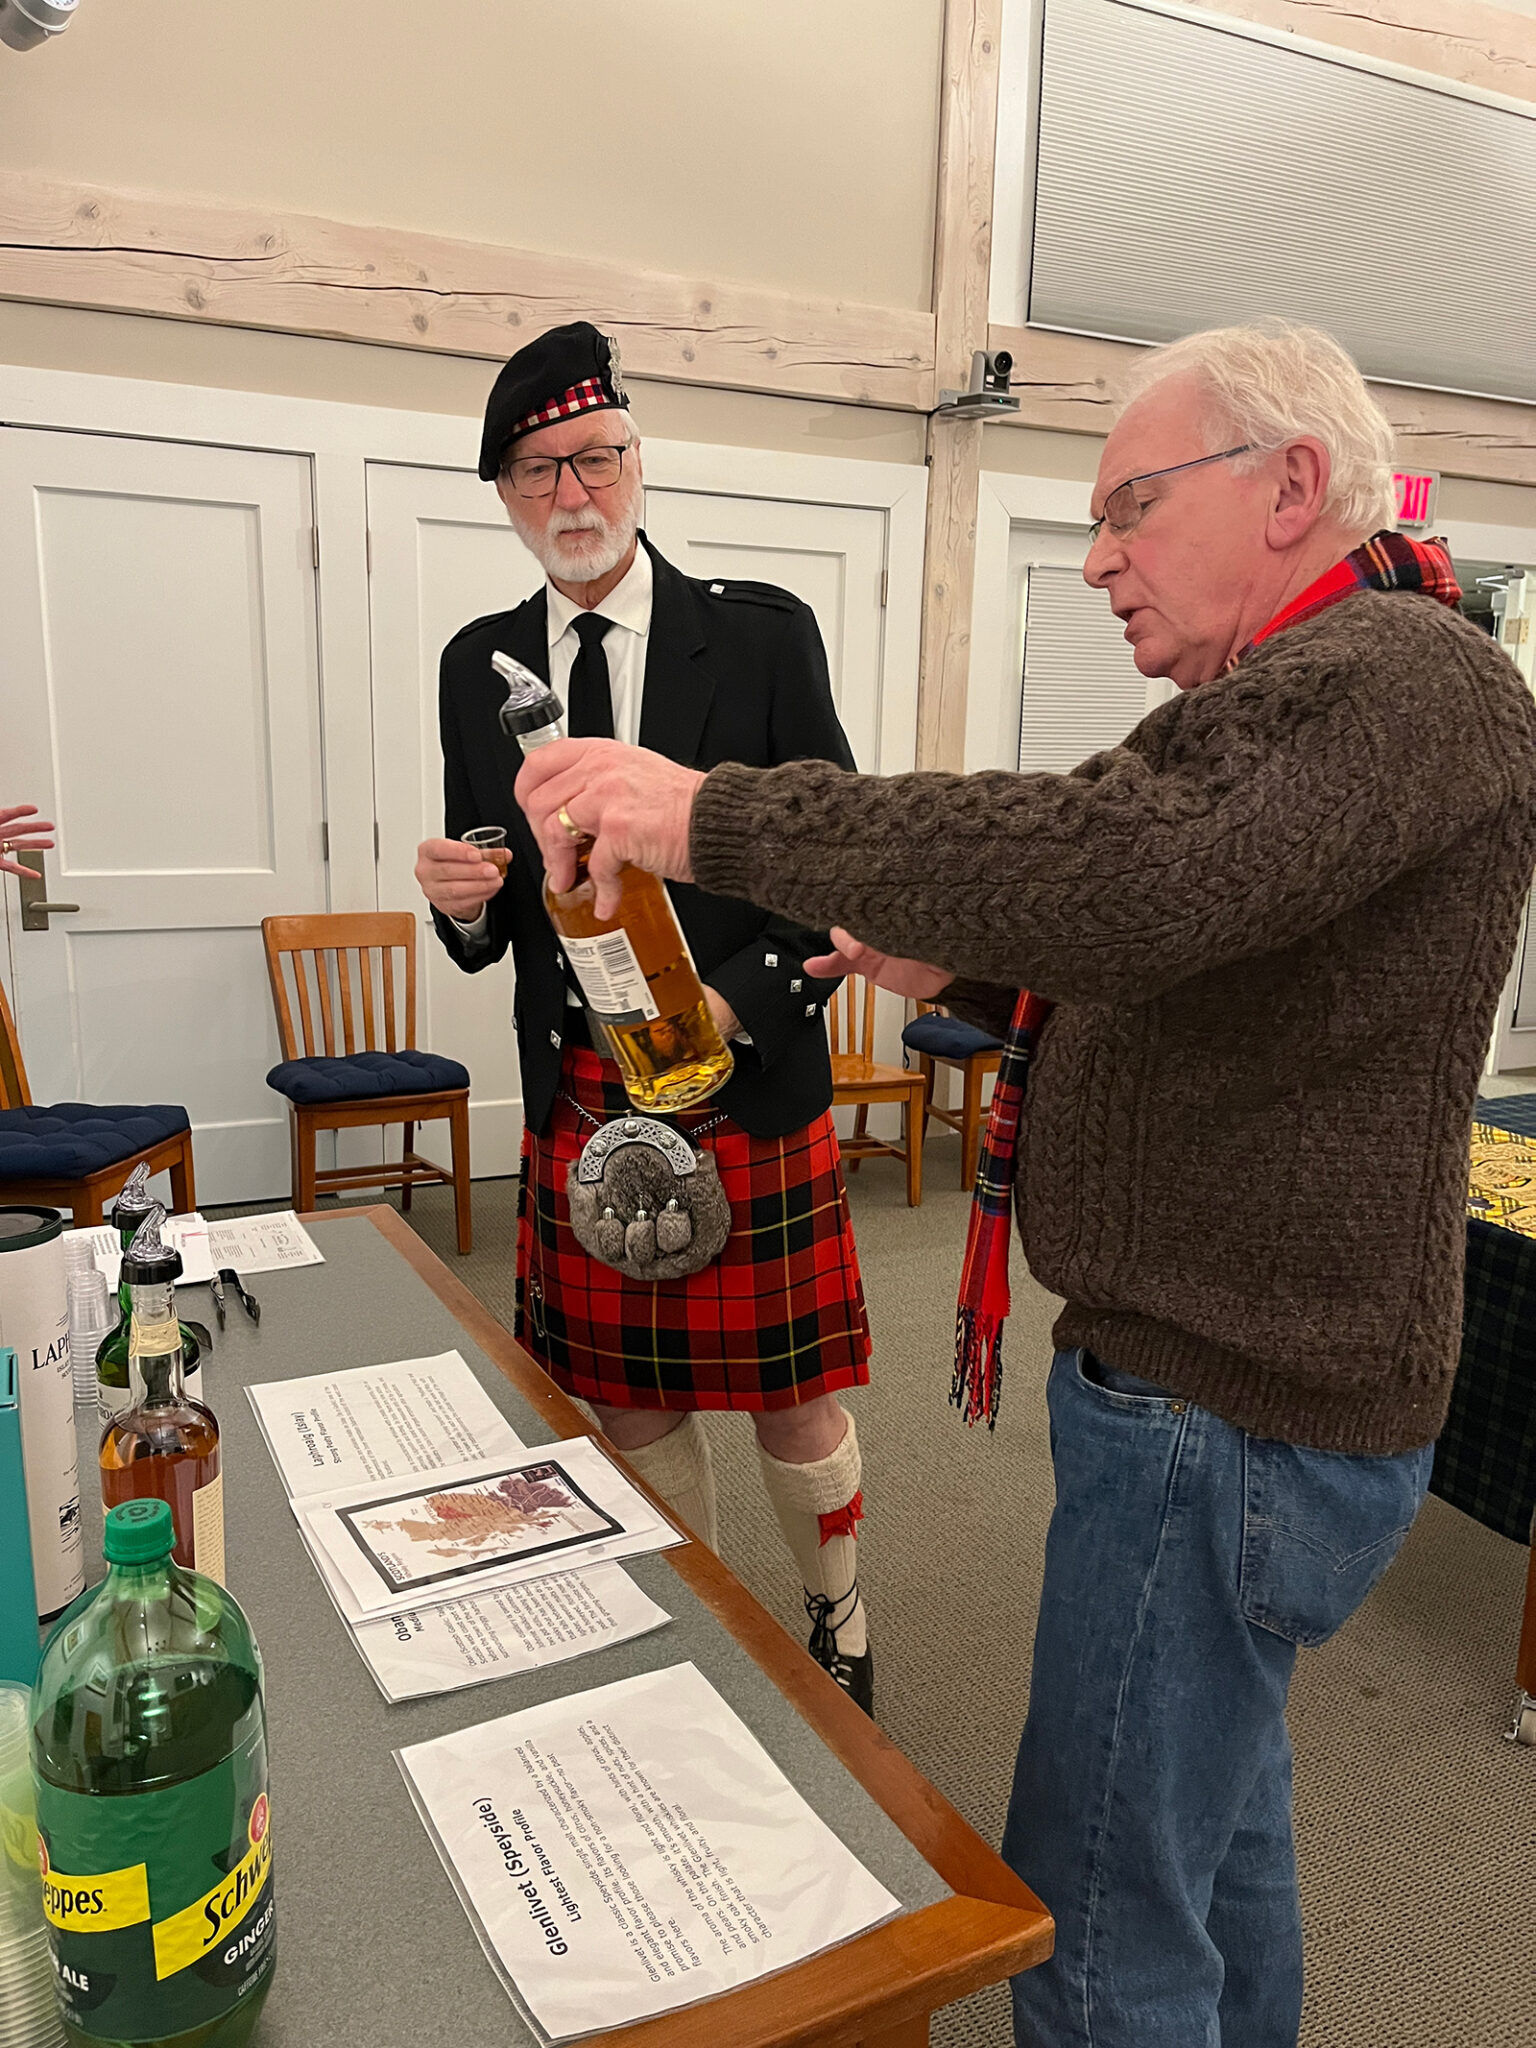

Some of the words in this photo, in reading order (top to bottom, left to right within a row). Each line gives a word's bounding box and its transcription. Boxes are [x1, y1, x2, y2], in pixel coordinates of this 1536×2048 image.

[300, 1432, 324, 1467] Laphroaig
[390, 1615, 411, 1641] Oban
[576, 1798, 603, 1835] non-smoky
[637, 1798, 654, 1814] with
[657, 1802, 681, 1830] whiskies
[511, 1807, 536, 1842] Profile
[639, 1823, 655, 1837] and
[683, 1821, 699, 1835] and
[471, 1795, 532, 1879] (Speyside)
[563, 1830, 580, 1847] malt
[580, 1833, 592, 1841] of
[602, 1841, 614, 1853] for
[649, 1837, 666, 1854] light
[670, 1842, 682, 1855] it's
[674, 1831, 703, 1863] Glenlivet
[530, 1842, 555, 1876] Flavor
[575, 1847, 592, 1869] single
[587, 1841, 607, 1867] flavors
[662, 1854, 671, 1862] is
[602, 1866, 614, 1878] Its
[609, 1852, 631, 1881] looking
[668, 1861, 689, 1887] whisky
[679, 1854, 702, 1880] palate,
[699, 1862, 713, 1877] The
[710, 1857, 729, 1877] light,
[203, 1832, 271, 1946] Schwe
[588, 1869, 613, 1904] Speyside
[611, 1878, 633, 1905] profile.
[626, 1880, 645, 1902] those
[696, 1880, 709, 1894] the
[709, 1878, 730, 1902] finish.
[725, 1877, 734, 1885] is
[546, 1876, 582, 1923] Lightest
[685, 1887, 698, 1902] the
[705, 1894, 718, 1907] On
[728, 1885, 746, 1902] that
[515, 1879, 570, 1957] Glenlivet
[609, 1903, 630, 1930] classic
[627, 1905, 646, 1929] flavor
[640, 1902, 664, 1927] please
[691, 1901, 705, 1911] of
[724, 1901, 741, 1916] oak
[667, 1916, 684, 1939] here.
[701, 1911, 723, 1937] aroma
[716, 1907, 738, 1932] pears.
[737, 1916, 760, 1943] smoky
[742, 1900, 773, 1938] character
[224, 1899, 273, 1965] GINGER
[629, 1937, 639, 1946] is
[657, 1928, 668, 1939] to
[729, 1932, 747, 1949] and
[639, 1929, 665, 1960] elegant
[663, 1937, 692, 1971] promise
[680, 1938, 702, 1967] flavors
[719, 1937, 734, 1955] The
[633, 1946, 662, 1983] Glenlivet
[658, 1960, 675, 1977] and
[62, 1964, 89, 1991] ALE
